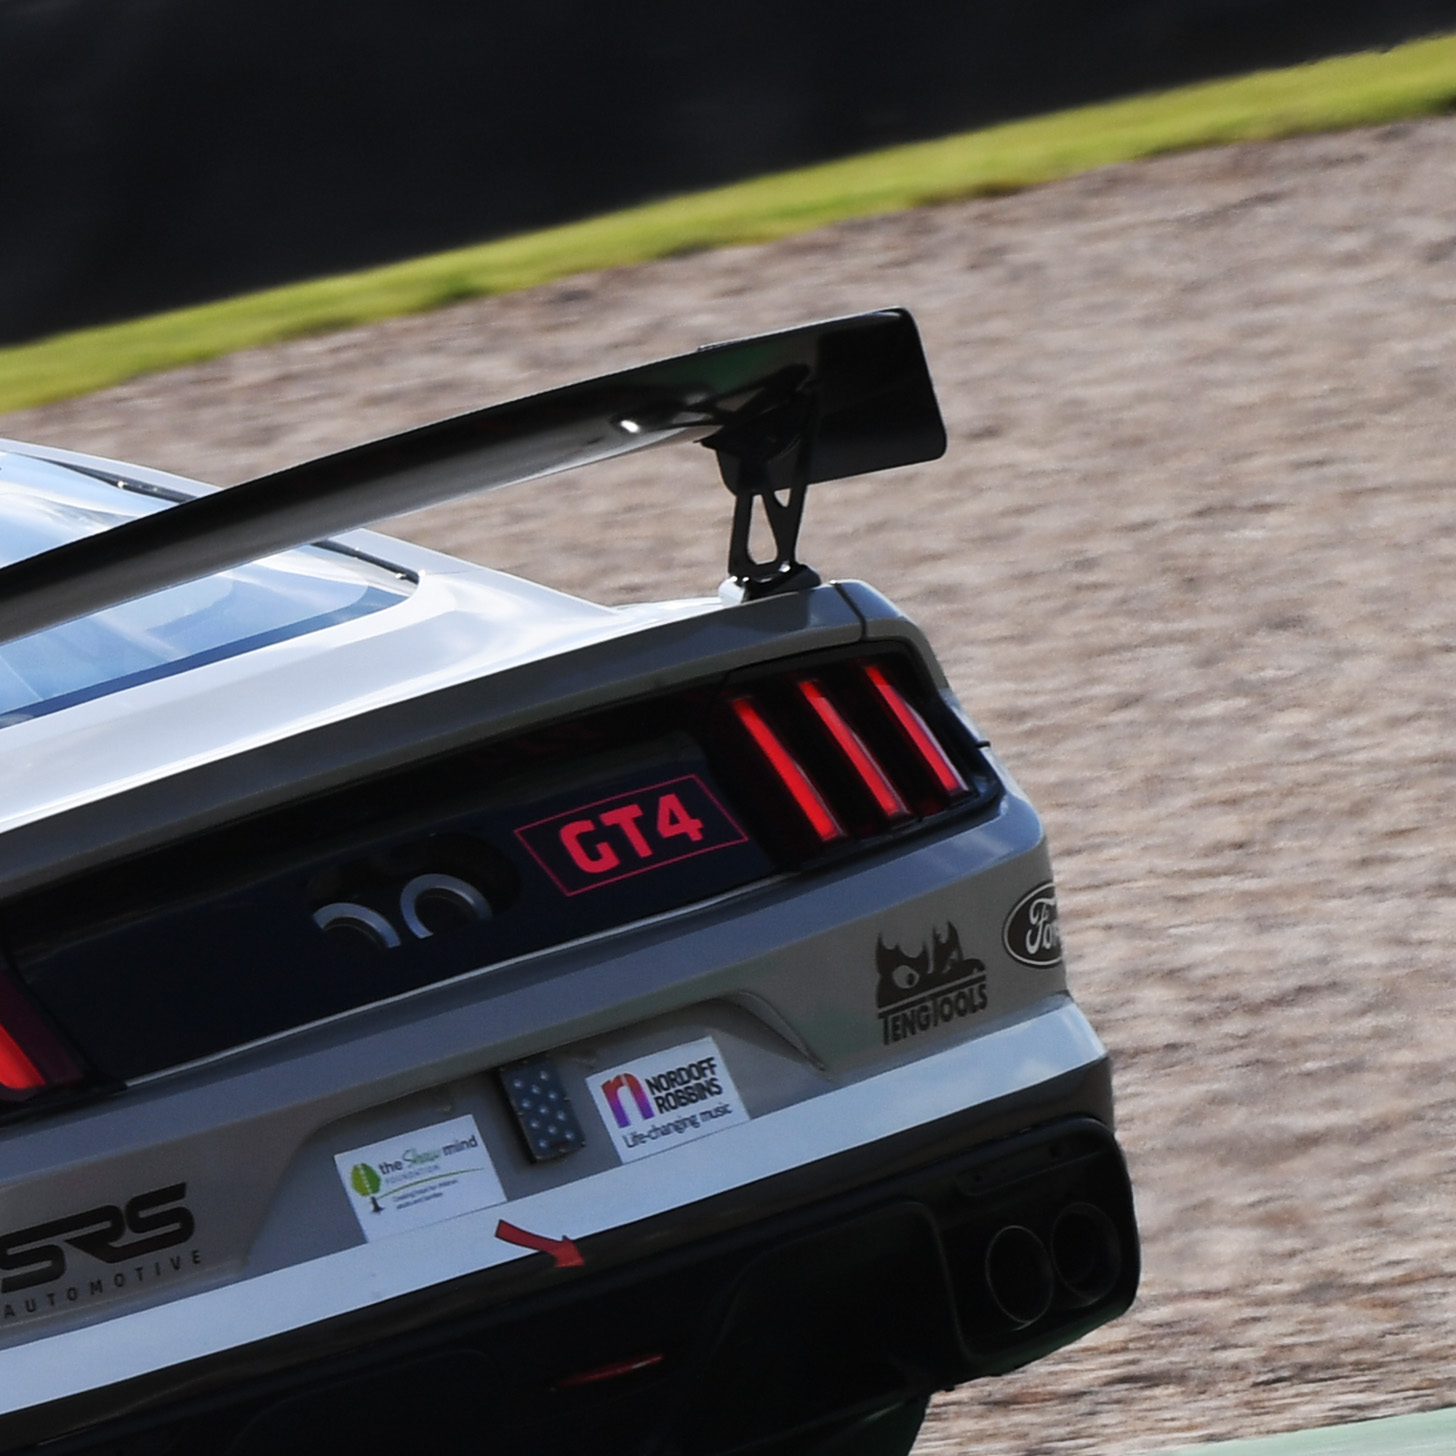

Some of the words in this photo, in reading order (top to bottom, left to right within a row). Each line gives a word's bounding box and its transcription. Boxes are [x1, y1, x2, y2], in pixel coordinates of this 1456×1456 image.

[559, 793, 704, 877] GT4
[1025, 897, 1063, 956] Fo
[645, 1056, 717, 1096] NORDOFF
[700, 1102, 733, 1123] music
[379, 1160, 403, 1174] the
[442, 1135, 478, 1156] mind
[2, 1249, 204, 1319] AUTOMOTIVE
